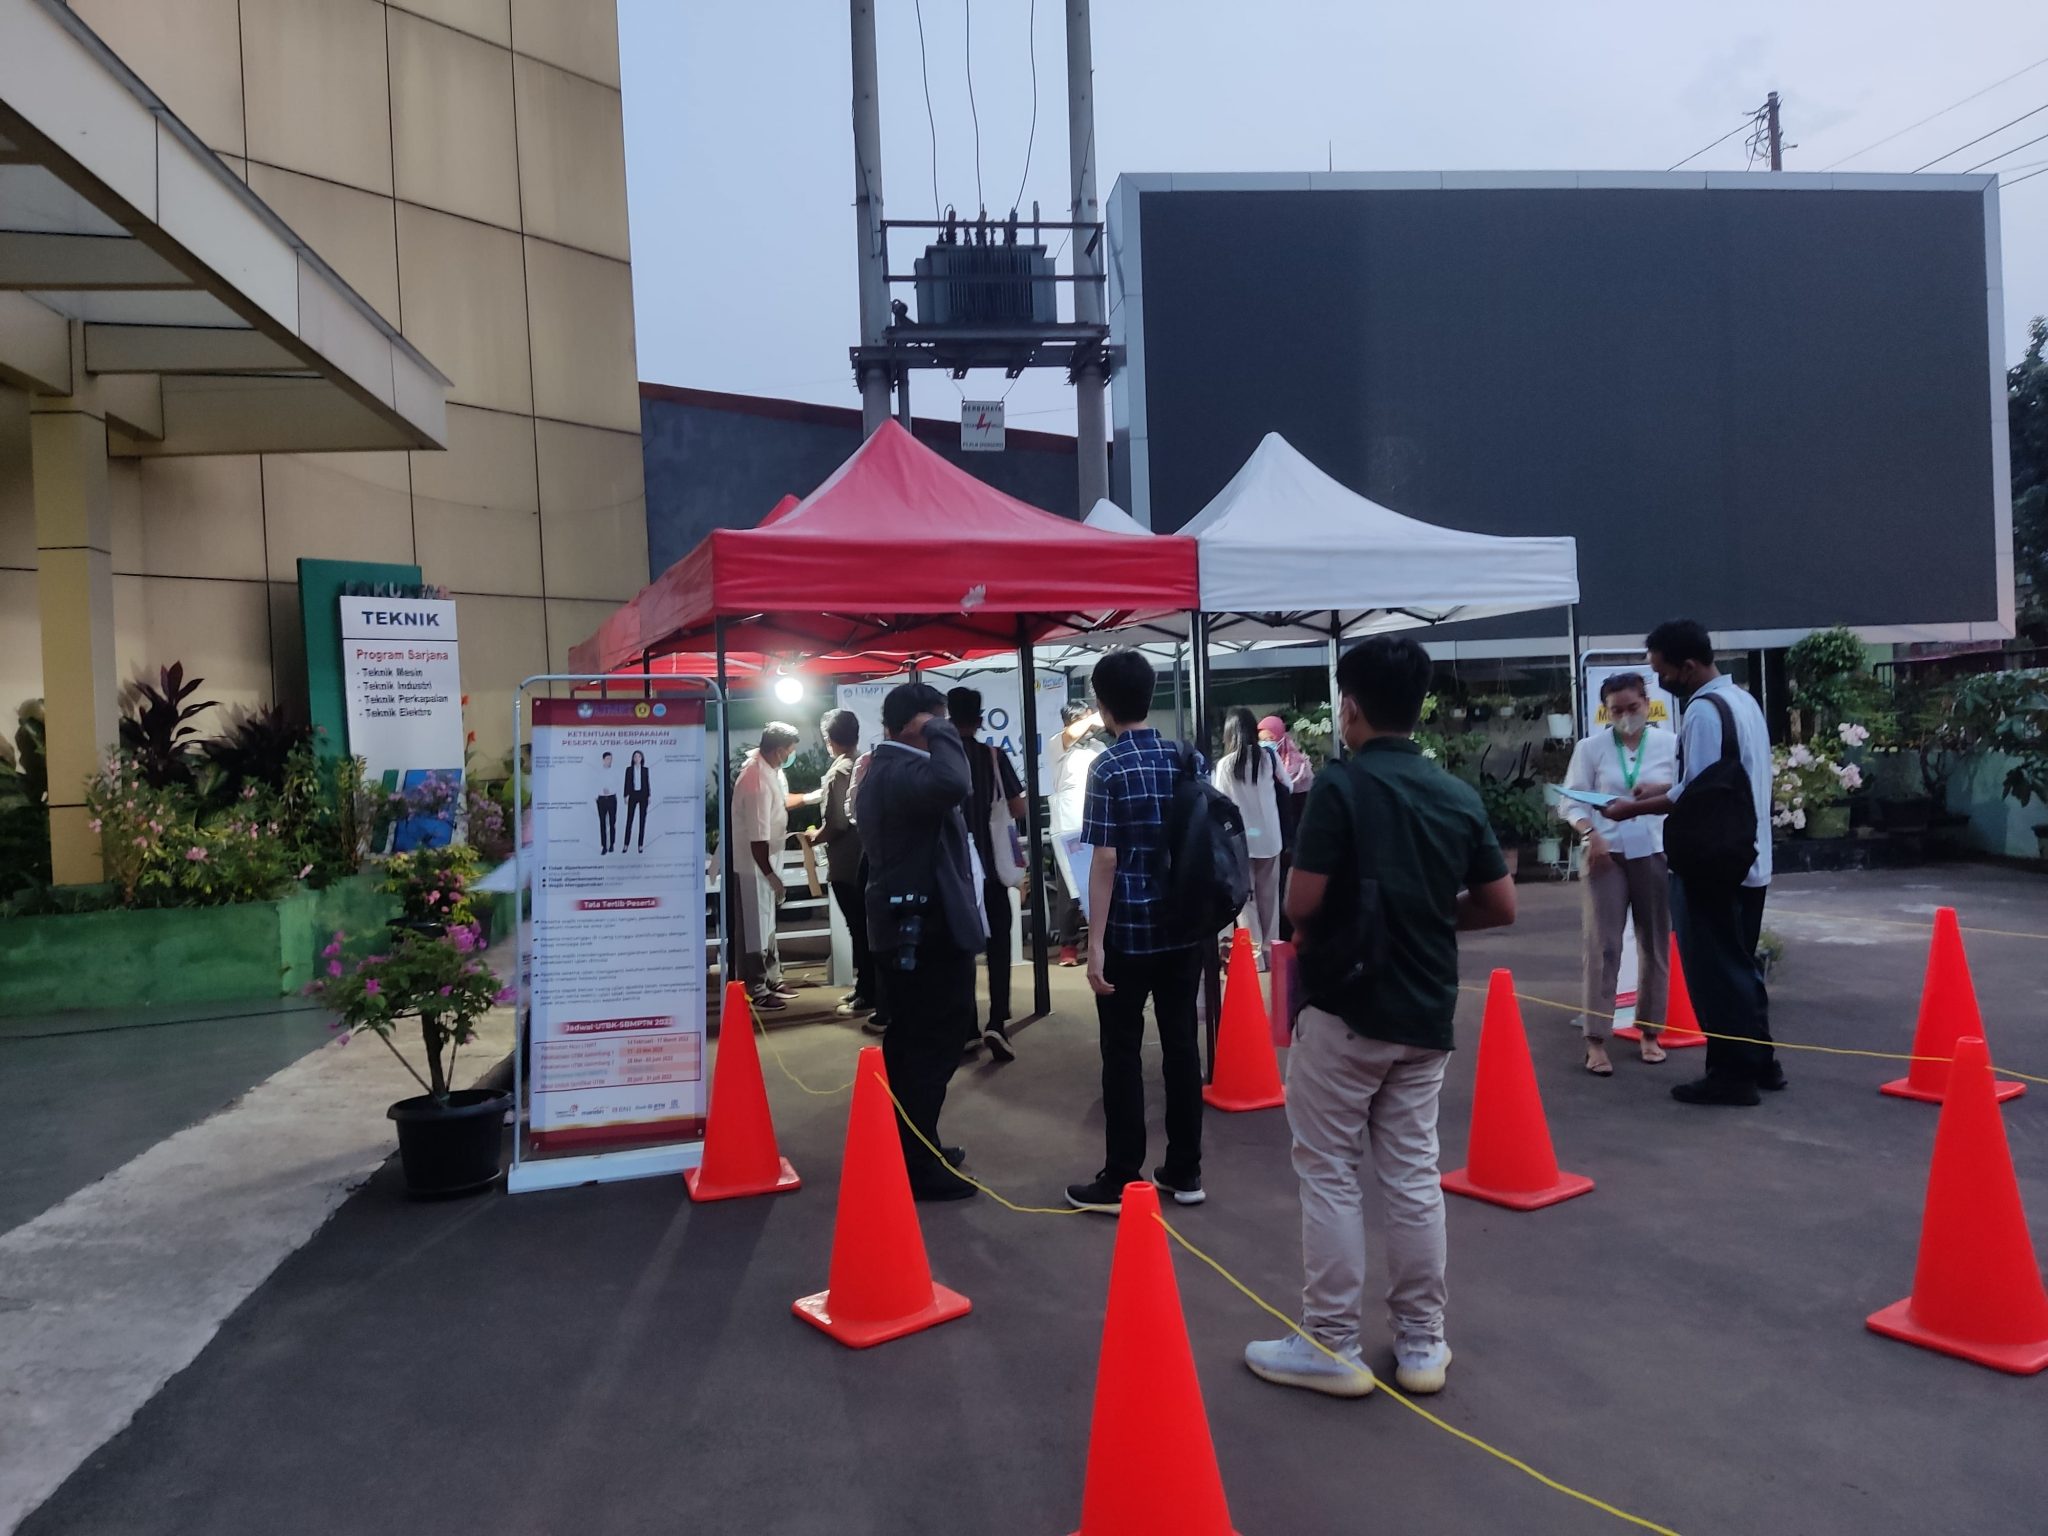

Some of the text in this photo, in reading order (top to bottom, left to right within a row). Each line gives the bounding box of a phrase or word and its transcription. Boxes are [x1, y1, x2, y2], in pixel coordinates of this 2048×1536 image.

[361, 611, 440, 626] TEKNIK
[356, 649, 449, 662] Program Sarjana
[362, 667, 423, 677] Teknik Mesin
[363, 680, 432, 691] Teknik Industri
[364, 693, 449, 706] Teknik Perkapalan
[365, 707, 432, 718] Teknik Elektro
[584, 899, 655, 909] Tata Tertib Peserta
[566, 1023, 593, 1032] Jadwal
